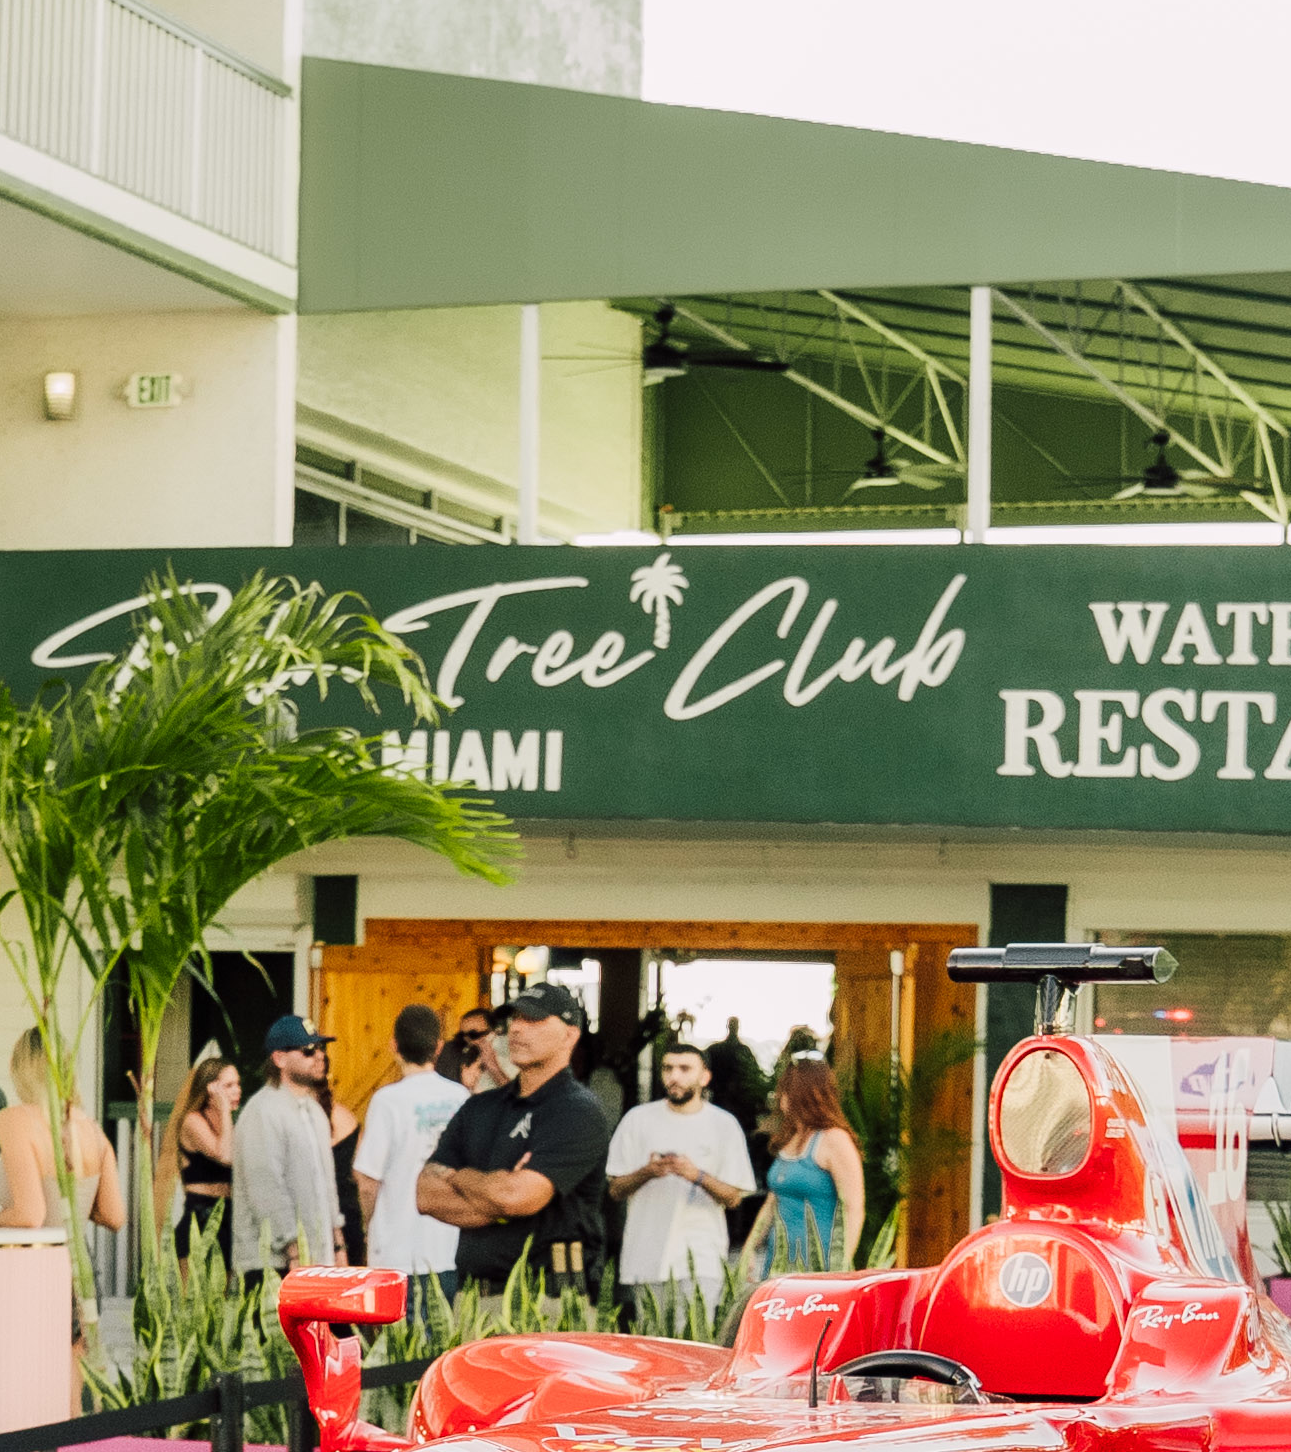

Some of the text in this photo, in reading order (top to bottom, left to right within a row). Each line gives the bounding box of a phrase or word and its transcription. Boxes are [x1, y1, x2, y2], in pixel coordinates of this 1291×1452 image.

[382, 575, 654, 709] Tree
[665, 572, 967, 720] Club
[381, 729, 562, 794] MIAMI
[1004, 1253, 1049, 1305] hp
[754, 1294, 840, 1323] Ray-Ban
[1132, 1301, 1221, 1331] Ray-Ban
